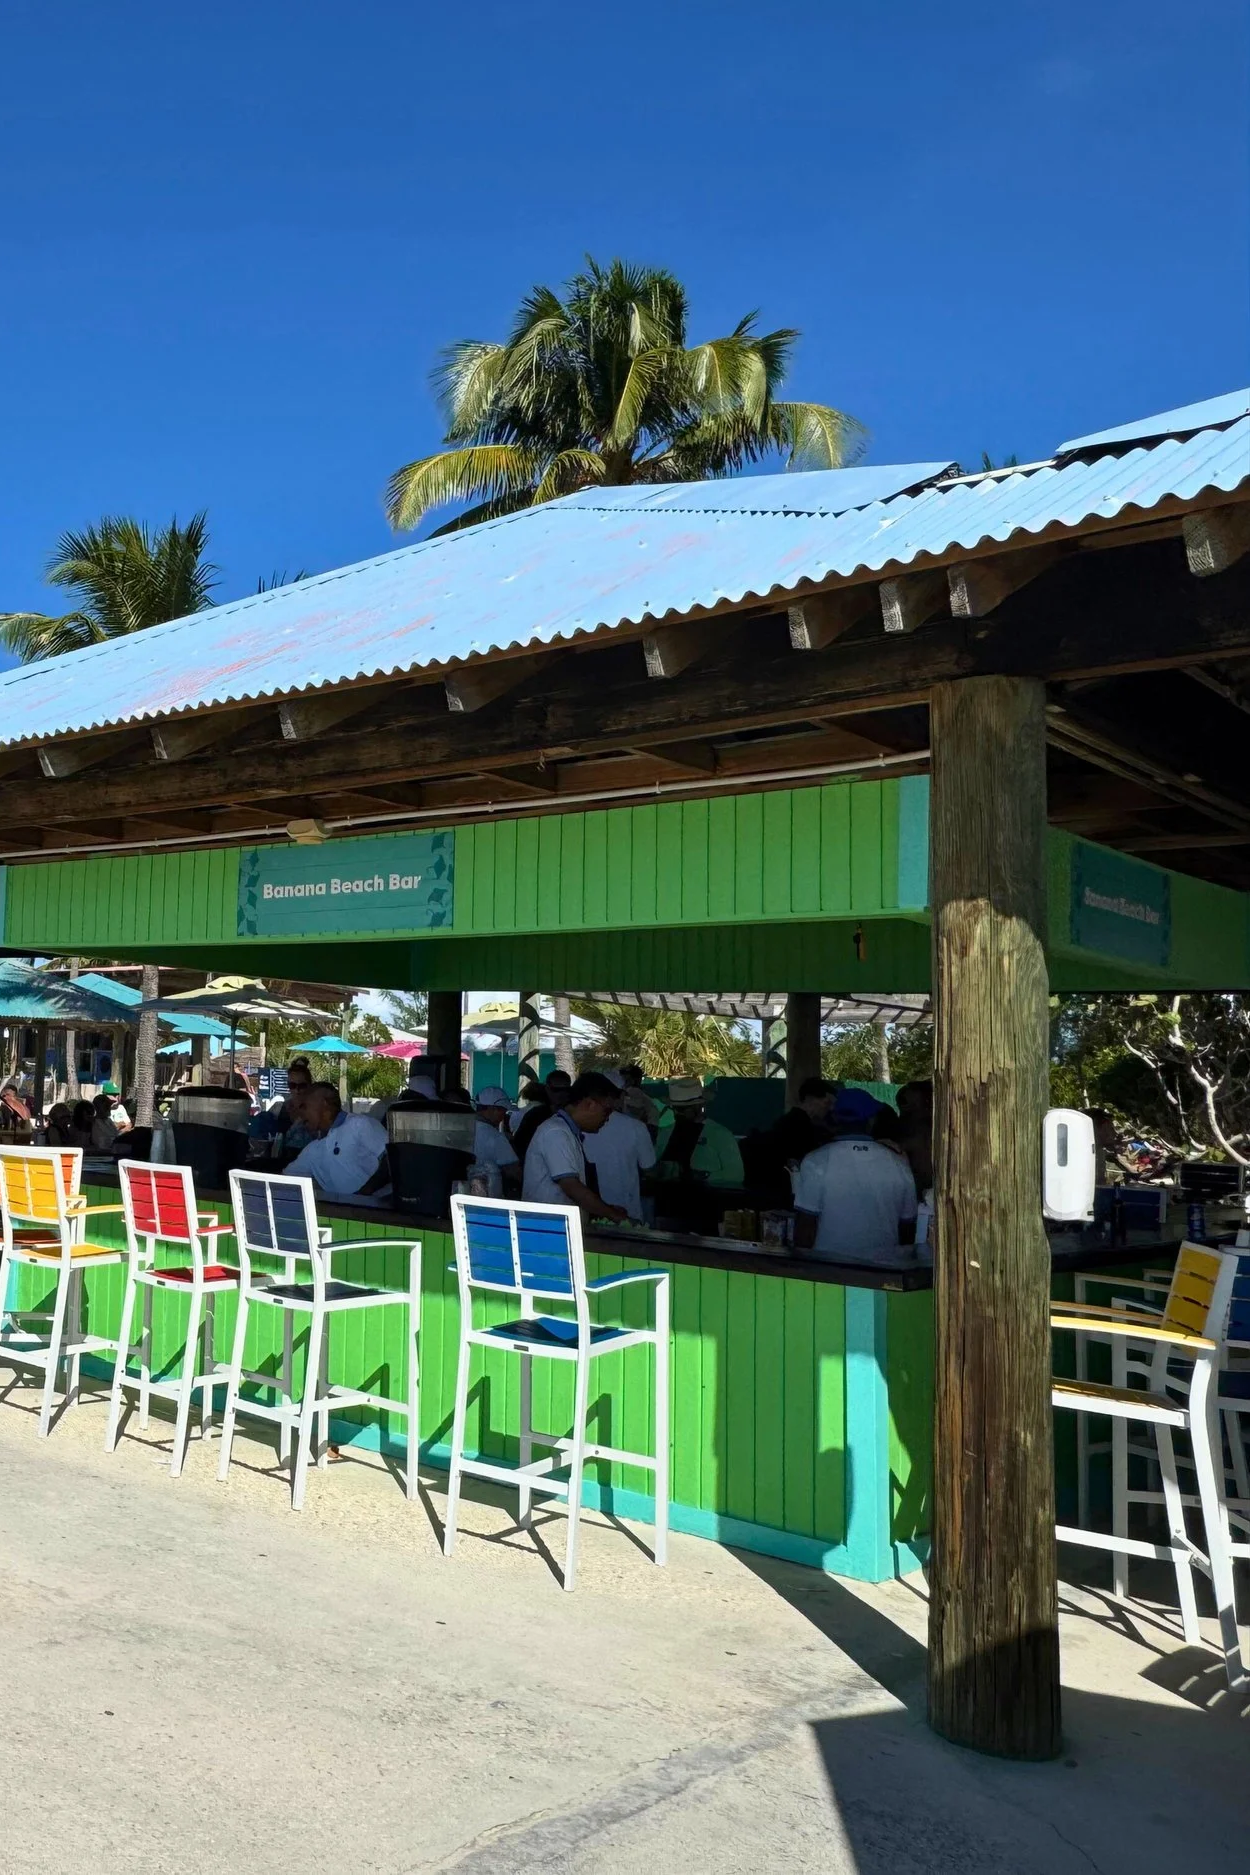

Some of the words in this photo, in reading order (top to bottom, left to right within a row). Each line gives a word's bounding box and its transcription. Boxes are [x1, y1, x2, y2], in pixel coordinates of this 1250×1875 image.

[263, 883, 327, 899] Banana
[330, 874, 385, 895] Beach
[388, 873, 422, 890] Bar
